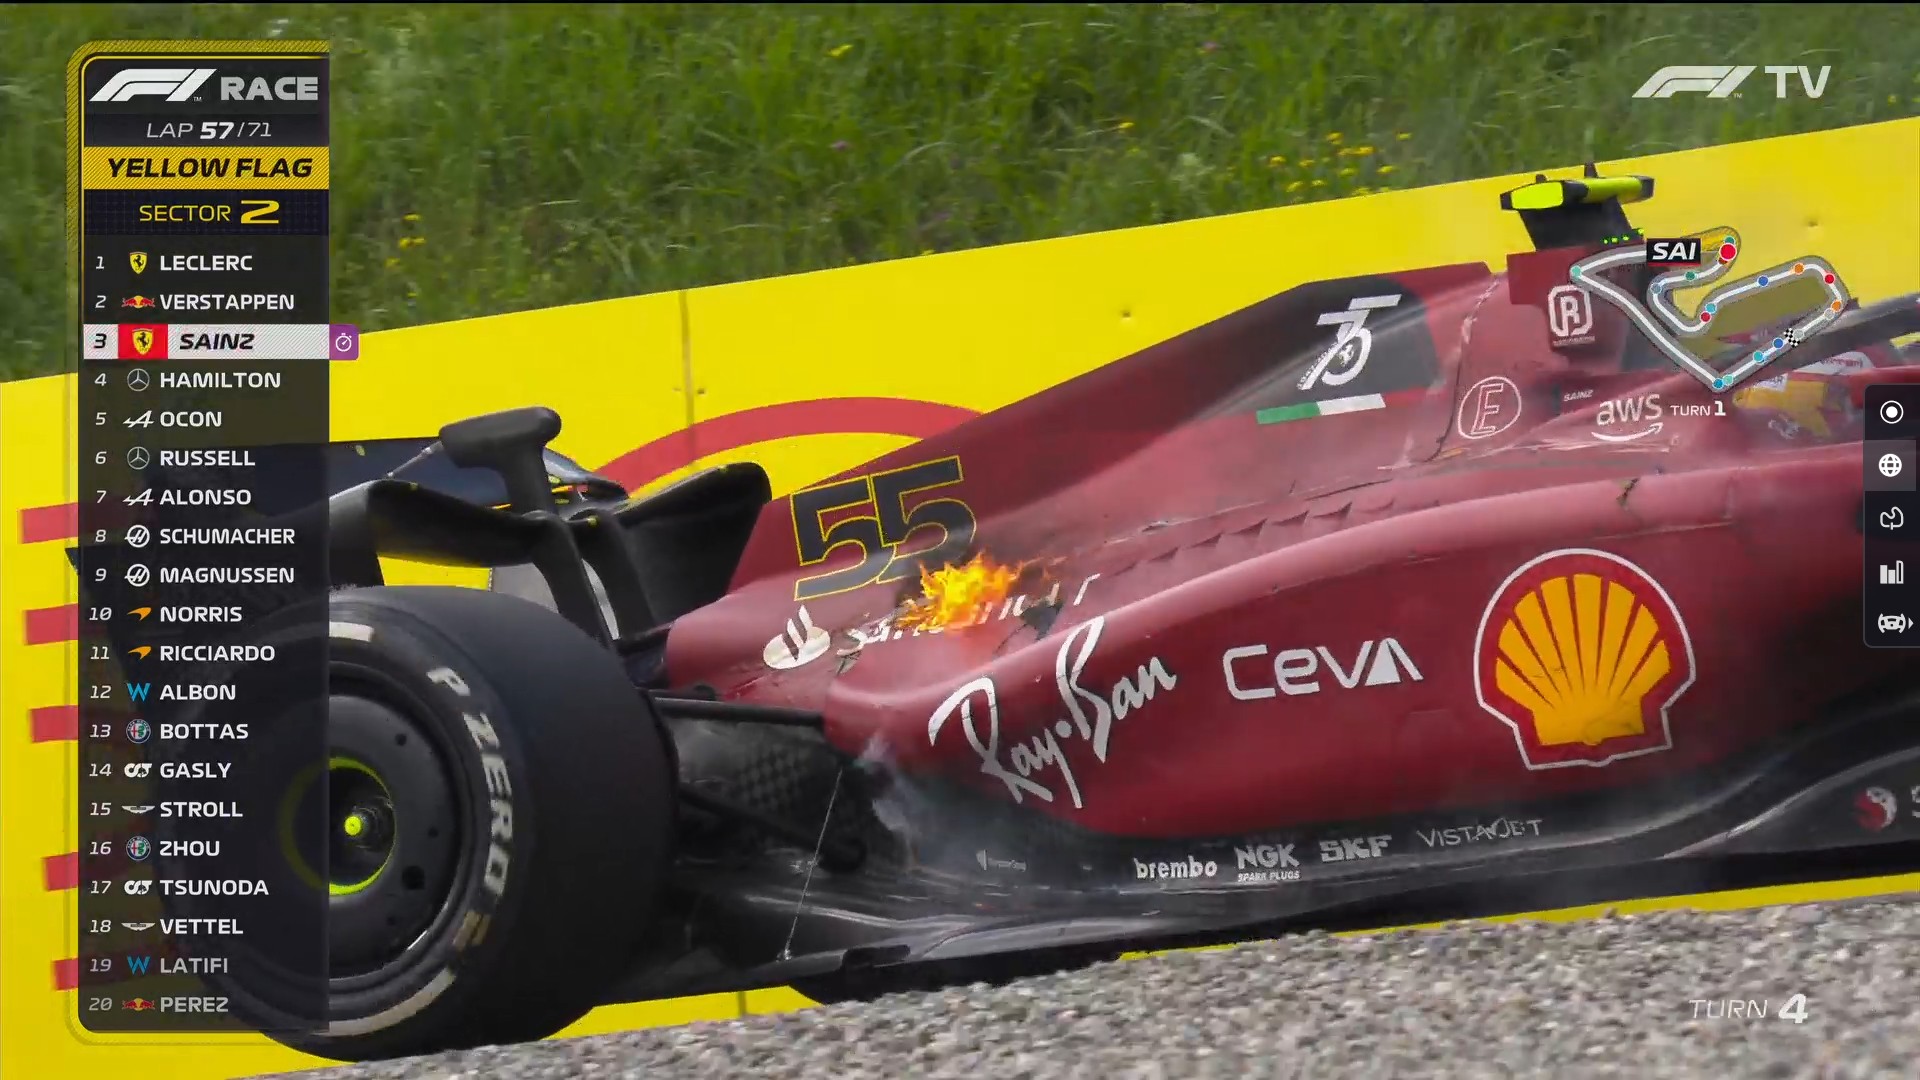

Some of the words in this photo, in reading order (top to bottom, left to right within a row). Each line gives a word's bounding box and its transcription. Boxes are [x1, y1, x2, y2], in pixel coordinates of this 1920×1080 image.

[1596, 393, 1664, 426] aws
[789, 455, 977, 602] 55
[1233, 843, 1300, 870] NGK
[1319, 834, 1392, 863] SKF
[1133, 854, 1218, 880] brembo
